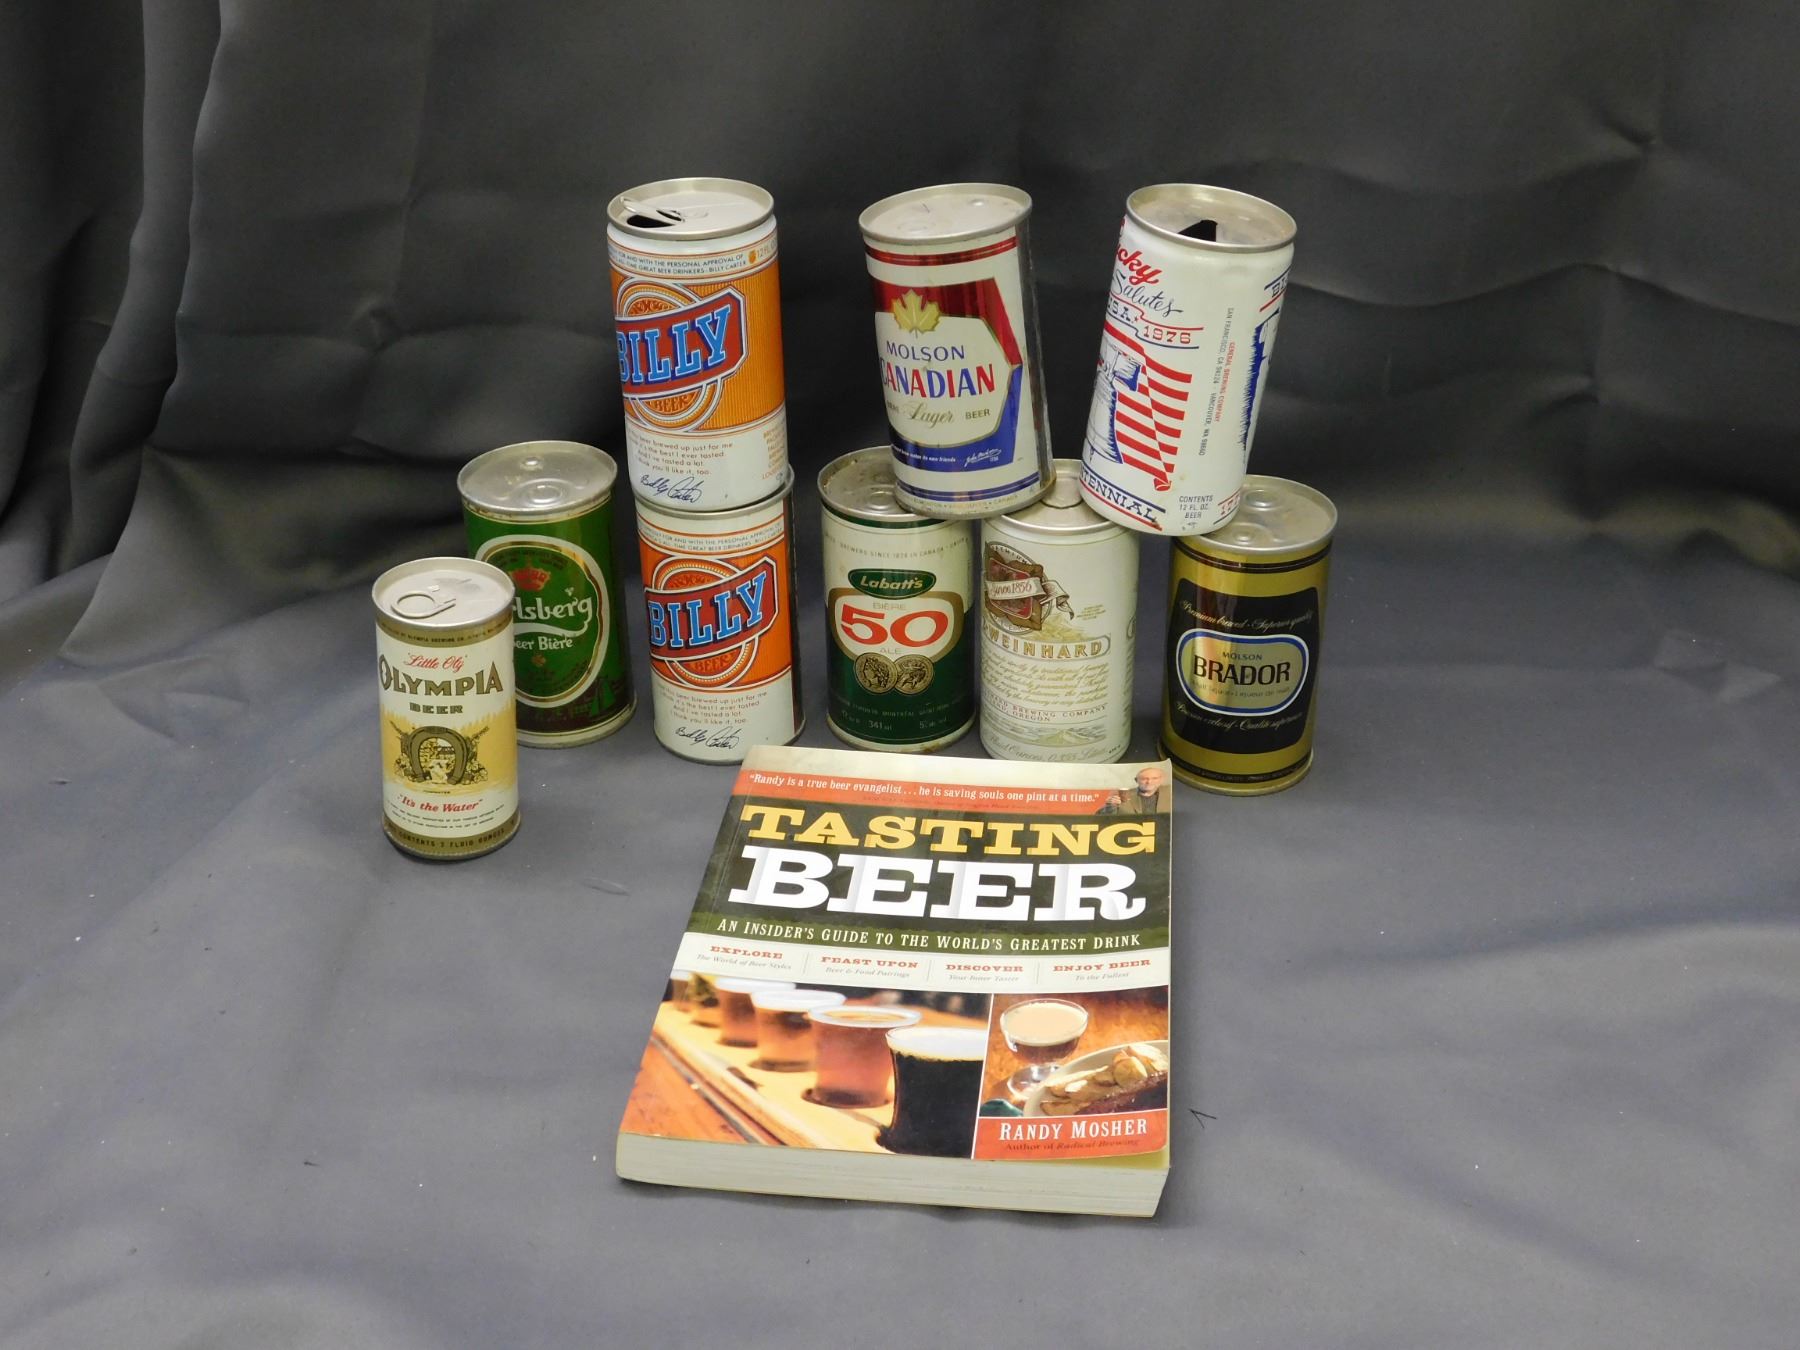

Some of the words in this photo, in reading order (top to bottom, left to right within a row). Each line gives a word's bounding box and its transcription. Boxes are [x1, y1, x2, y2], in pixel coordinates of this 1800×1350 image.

[703, 256, 734, 266] APPROVAL
[1117, 244, 1162, 285] cky
[1111, 268, 1184, 317] Salutes
[1226, 307, 1234, 318] SAN
[1143, 325, 1191, 344] 1976
[616, 303, 731, 385] BILLY
[886, 340, 965, 362] MOLSON
[1216, 356, 1225, 365] CA
[880, 357, 996, 399] CANADIAN
[654, 394, 689, 412] BEER
[1214, 395, 1224, 422] COMPANY
[904, 400, 954, 428] Lager
[965, 408, 991, 420] BEER
[1179, 495, 1213, 503] CONTENTS
[1185, 511, 1202, 519] BEER
[870, 551, 890, 559] SINCE
[860, 575, 924, 591] Labatt's
[512, 596, 592, 623] lsberg
[648, 571, 767, 648] BILLY
[841, 603, 949, 648] 50
[514, 639, 534, 650] eer
[538, 636, 573, 651] Bière
[989, 626, 1102, 659] WEINHARD
[695, 655, 731, 673] BEER
[1223, 651, 1263, 661] MOLSON
[378, 653, 504, 697] OLYMPIA
[1193, 654, 1291, 686] BRADOR
[410, 702, 463, 715] BEER
[1013, 705, 1056, 717] BREWING
[1062, 705, 1106, 717] COMPANY
[1013, 711, 1051, 722] OREGON
[787, 776, 796, 786] is
[807, 779, 828, 789] true
[830, 780, 851, 791] beer
[918, 786, 930, 796] he
[933, 787, 942, 797] is
[944, 788, 976, 800] saving
[979, 790, 1004, 800] souls
[1007, 792, 1024, 801] one
[1026, 791, 1046, 803] pint
[1049, 793, 1059, 802] at
[420, 802, 439, 812] the
[740, 804, 1156, 857] TASTING
[727, 844, 1147, 922] BEER
[717, 918, 738, 933] AN
[743, 921, 815, 940] INSIDER'S
[821, 928, 869, 944] GUIDE
[876, 932, 894, 945] TO
[900, 934, 929, 947] THE
[937, 935, 1003, 950] WORLD'S
[1010, 938, 1087, 950] GREATEST
[1093, 934, 1141, 949] DRINK
[710, 945, 783, 960] EXPLORE
[713, 955, 738, 966] World
[739, 957, 748, 966] of
[769, 961, 793, 971] Styles
[821, 956, 872, 966] FEAST
[877, 960, 919, 969] UPON
[946, 963, 1024, 973] DISCOVER
[1053, 963, 1104, 972] ENJOY
[1108, 959, 1152, 970] BEER
[999, 1121, 1064, 1142] RANDY
[1070, 1118, 1148, 1140] MOSHER
[1005, 1142, 1040, 1152] Author
[1044, 1142, 1054, 1151] of
